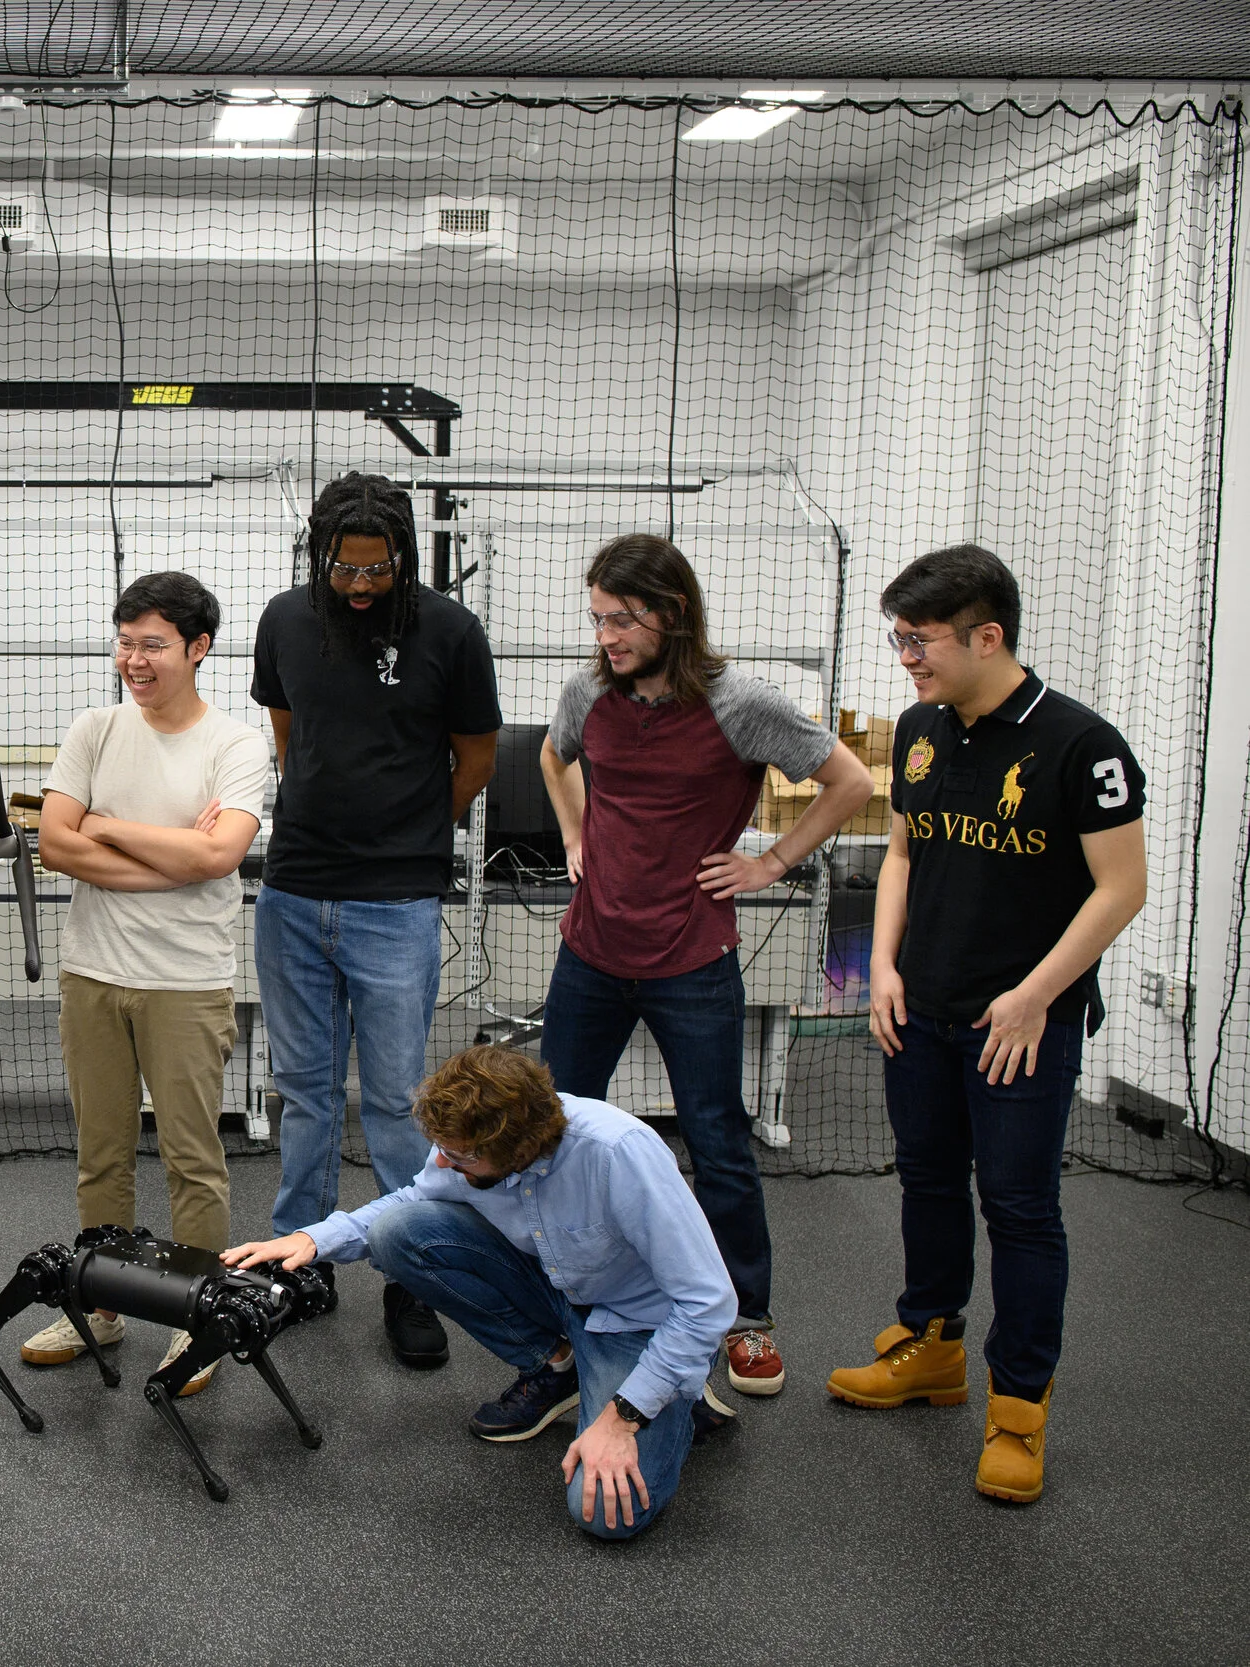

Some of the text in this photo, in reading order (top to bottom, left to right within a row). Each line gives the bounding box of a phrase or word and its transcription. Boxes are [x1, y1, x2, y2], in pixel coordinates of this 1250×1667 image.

[132, 385, 195, 404] JEGS
[1092, 757, 1129, 809] 3
[906, 811, 1046, 855] AS VEGAS
